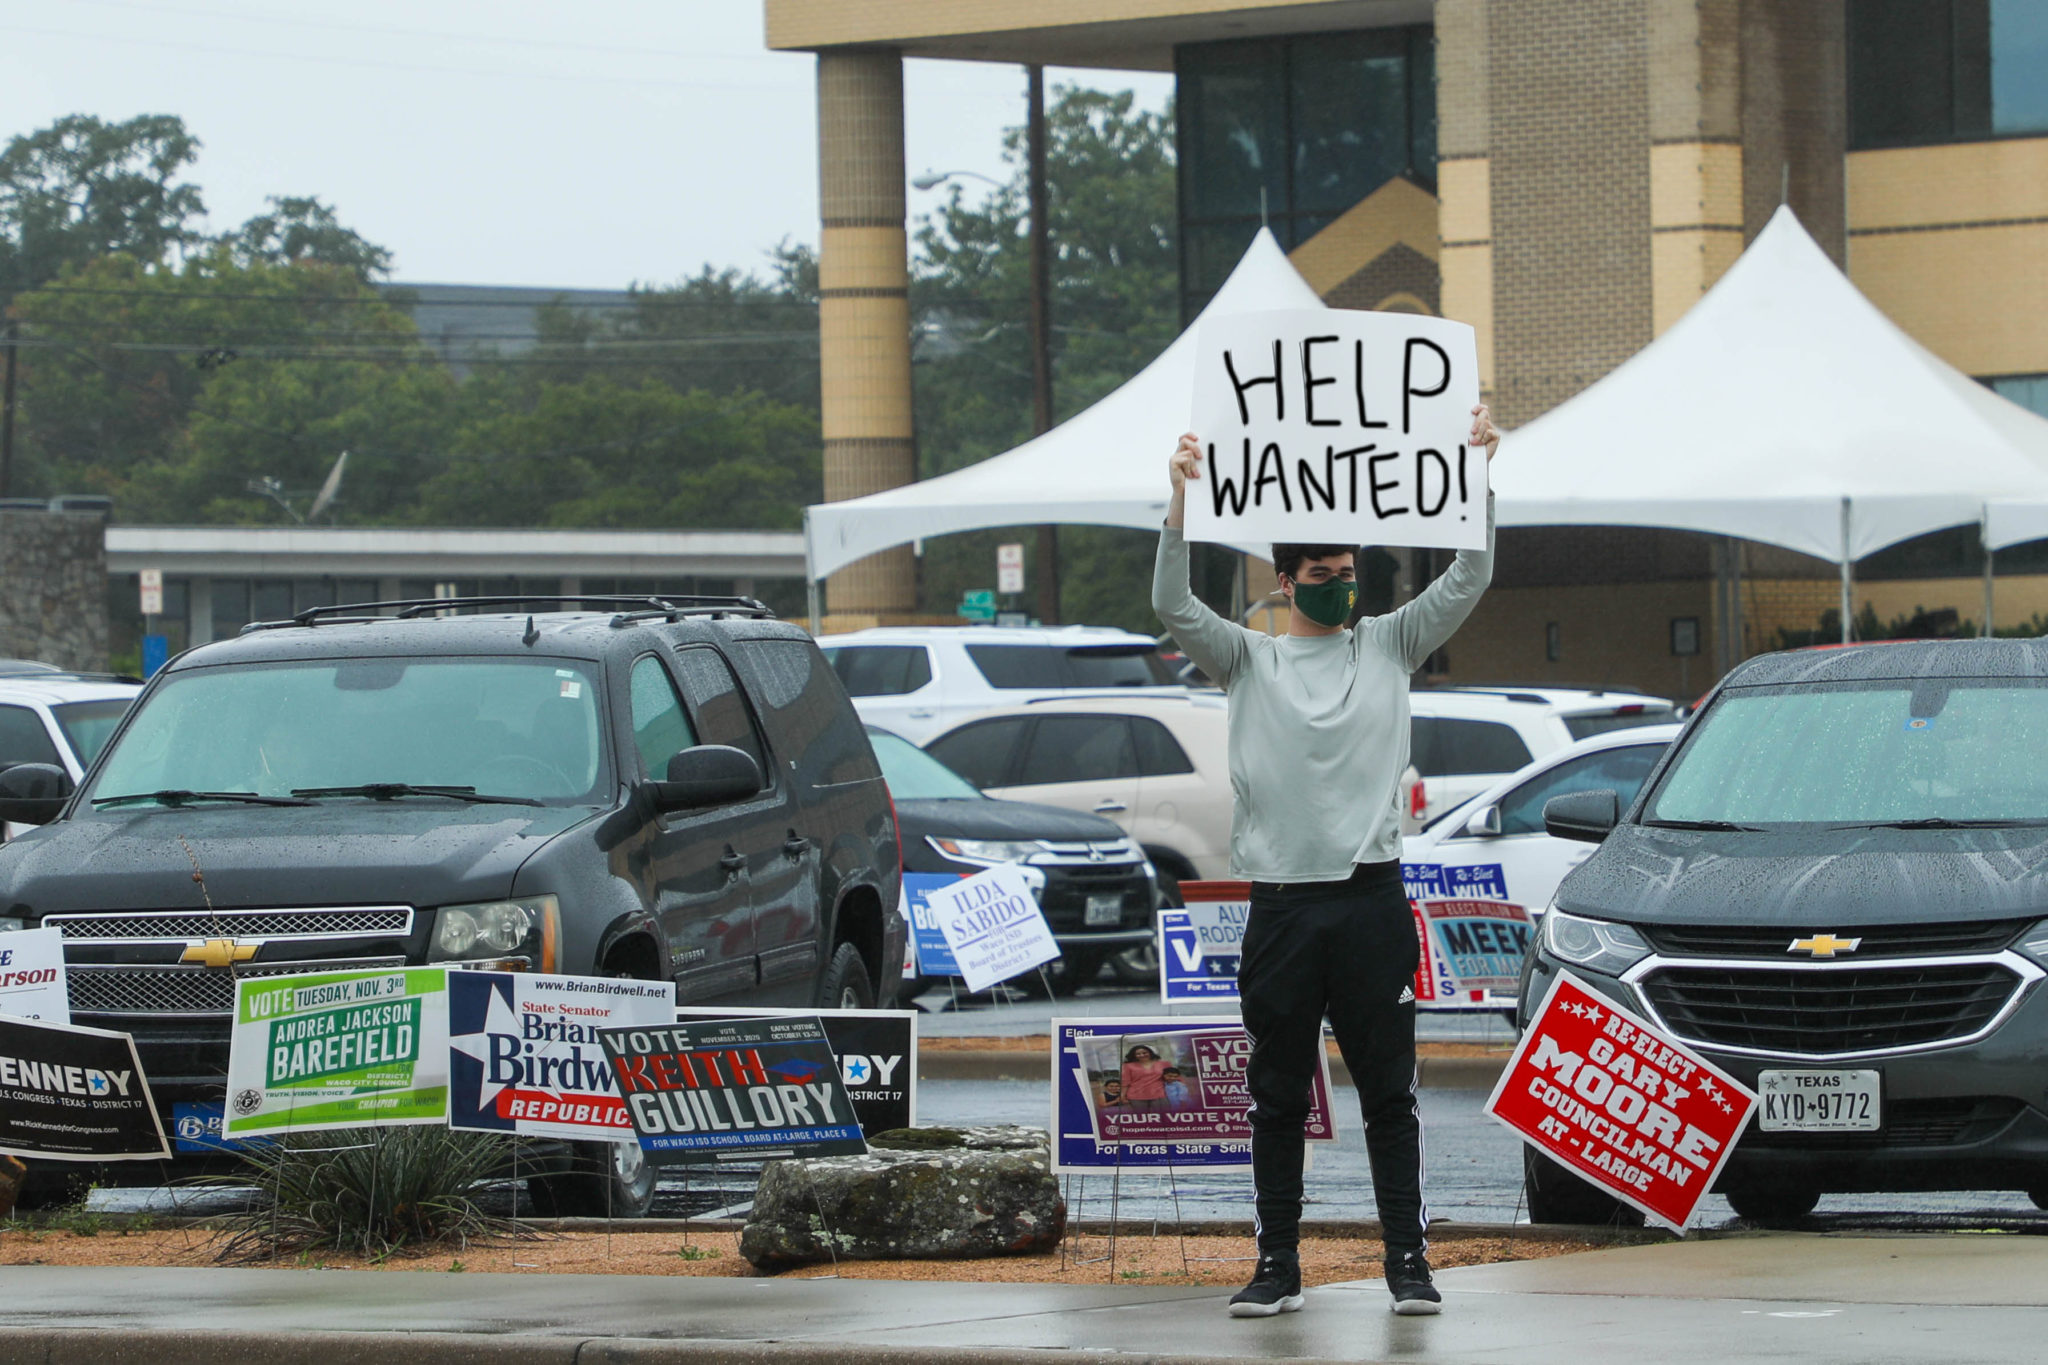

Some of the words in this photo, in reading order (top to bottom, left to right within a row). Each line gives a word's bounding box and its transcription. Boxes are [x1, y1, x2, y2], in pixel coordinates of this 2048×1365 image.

[1223, 335, 1451, 434] HELP
[1208, 438, 1468, 522] WANTED!
[952, 880, 1007, 914] ILDA
[1403, 882, 1446, 899] WILL
[1453, 882, 1504, 899] WILL
[951, 895, 1027, 941] SABIDO
[1445, 902, 1477, 915] ELECT
[1456, 957, 1492, 976] FOR
[249, 988, 293, 1018] VOTE
[297, 984, 351, 1007] TUESDAY,
[356, 980, 382, 998] NOV.
[535, 980, 666, 998] www.BrianBirdwell.net
[522, 1001, 555, 1013] State
[558, 1004, 611, 1017] Senator
[275, 1015, 335, 1043] ANDREA
[341, 1003, 412, 1031] JACKSON
[1065, 1028, 1094, 1037] Elect
[272, 1024, 413, 1081] BAREFIELD
[605, 1029, 694, 1055] VOTE
[1602, 1014, 1698, 1082] RE-ELECT
[487, 1033, 615, 1092] Birdw
[613, 1049, 769, 1092] KEITH
[1588, 1037, 1691, 1109] GARY
[1208, 1084, 1251, 1095] WAC
[1795, 1076, 1840, 1087] TEXAS
[13, 1091, 55, 1104] CONGRESS
[60, 1097, 86, 1108] TEXAS
[93, 1100, 132, 1109] DISTRICT
[133, 1101, 142, 1109] 17
[629, 1083, 837, 1134] GUILLORY
[892, 1091, 902, 1100] 17
[1528, 1033, 1721, 1171] MOORE
[509, 1099, 632, 1126] REPUBLIC
[1105, 1113, 1161, 1124] YOUR
[1166, 1112, 1220, 1123] VOTE
[652, 1139, 670, 1148] FOR
[670, 1138, 694, 1147] WACO
[695, 1136, 709, 1146] ISD
[710, 1135, 743, 1145] SCHOOL
[744, 1133, 771, 1144] BOARD
[815, 1130, 839, 1140] PLACE
[841, 1129, 848, 1138] 6
[1528, 1077, 1693, 1187] COUNCILMAN
[1096, 1144, 1118, 1154] For
[1126, 1144, 1168, 1155] Texas
[1176, 1143, 1211, 1154] State
[1219, 1142, 1252, 1153] Sena
[1537, 1114, 1569, 1142] AT
[1580, 1141, 1654, 1192] LARGE
